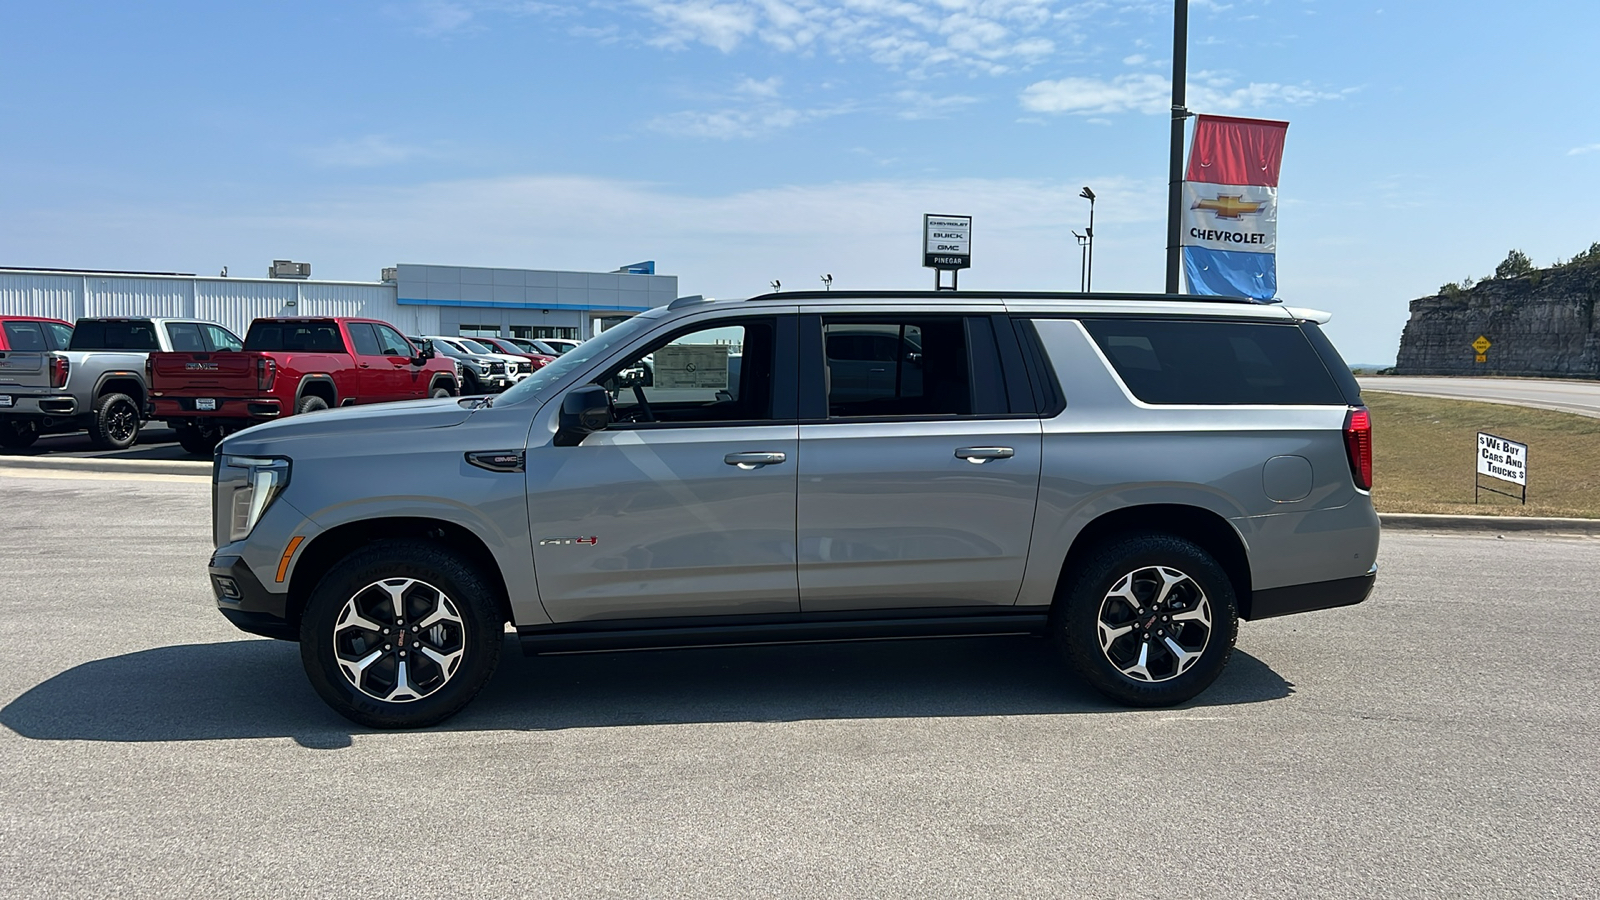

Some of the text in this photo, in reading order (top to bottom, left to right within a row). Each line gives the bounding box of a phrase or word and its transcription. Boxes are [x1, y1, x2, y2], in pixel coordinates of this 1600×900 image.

[1190, 227, 1266, 245] CHEVROLET
[934, 257, 962, 265] PINEGAR
[185, 362, 218, 371] GMC
[1486, 437, 1501, 451] WE
[1503, 441, 1520, 456] BUY
[1482, 448, 1523, 469] CARS AND
[1487, 461, 1517, 479] TRUCKS
[539, 535, 598, 547] AT4
